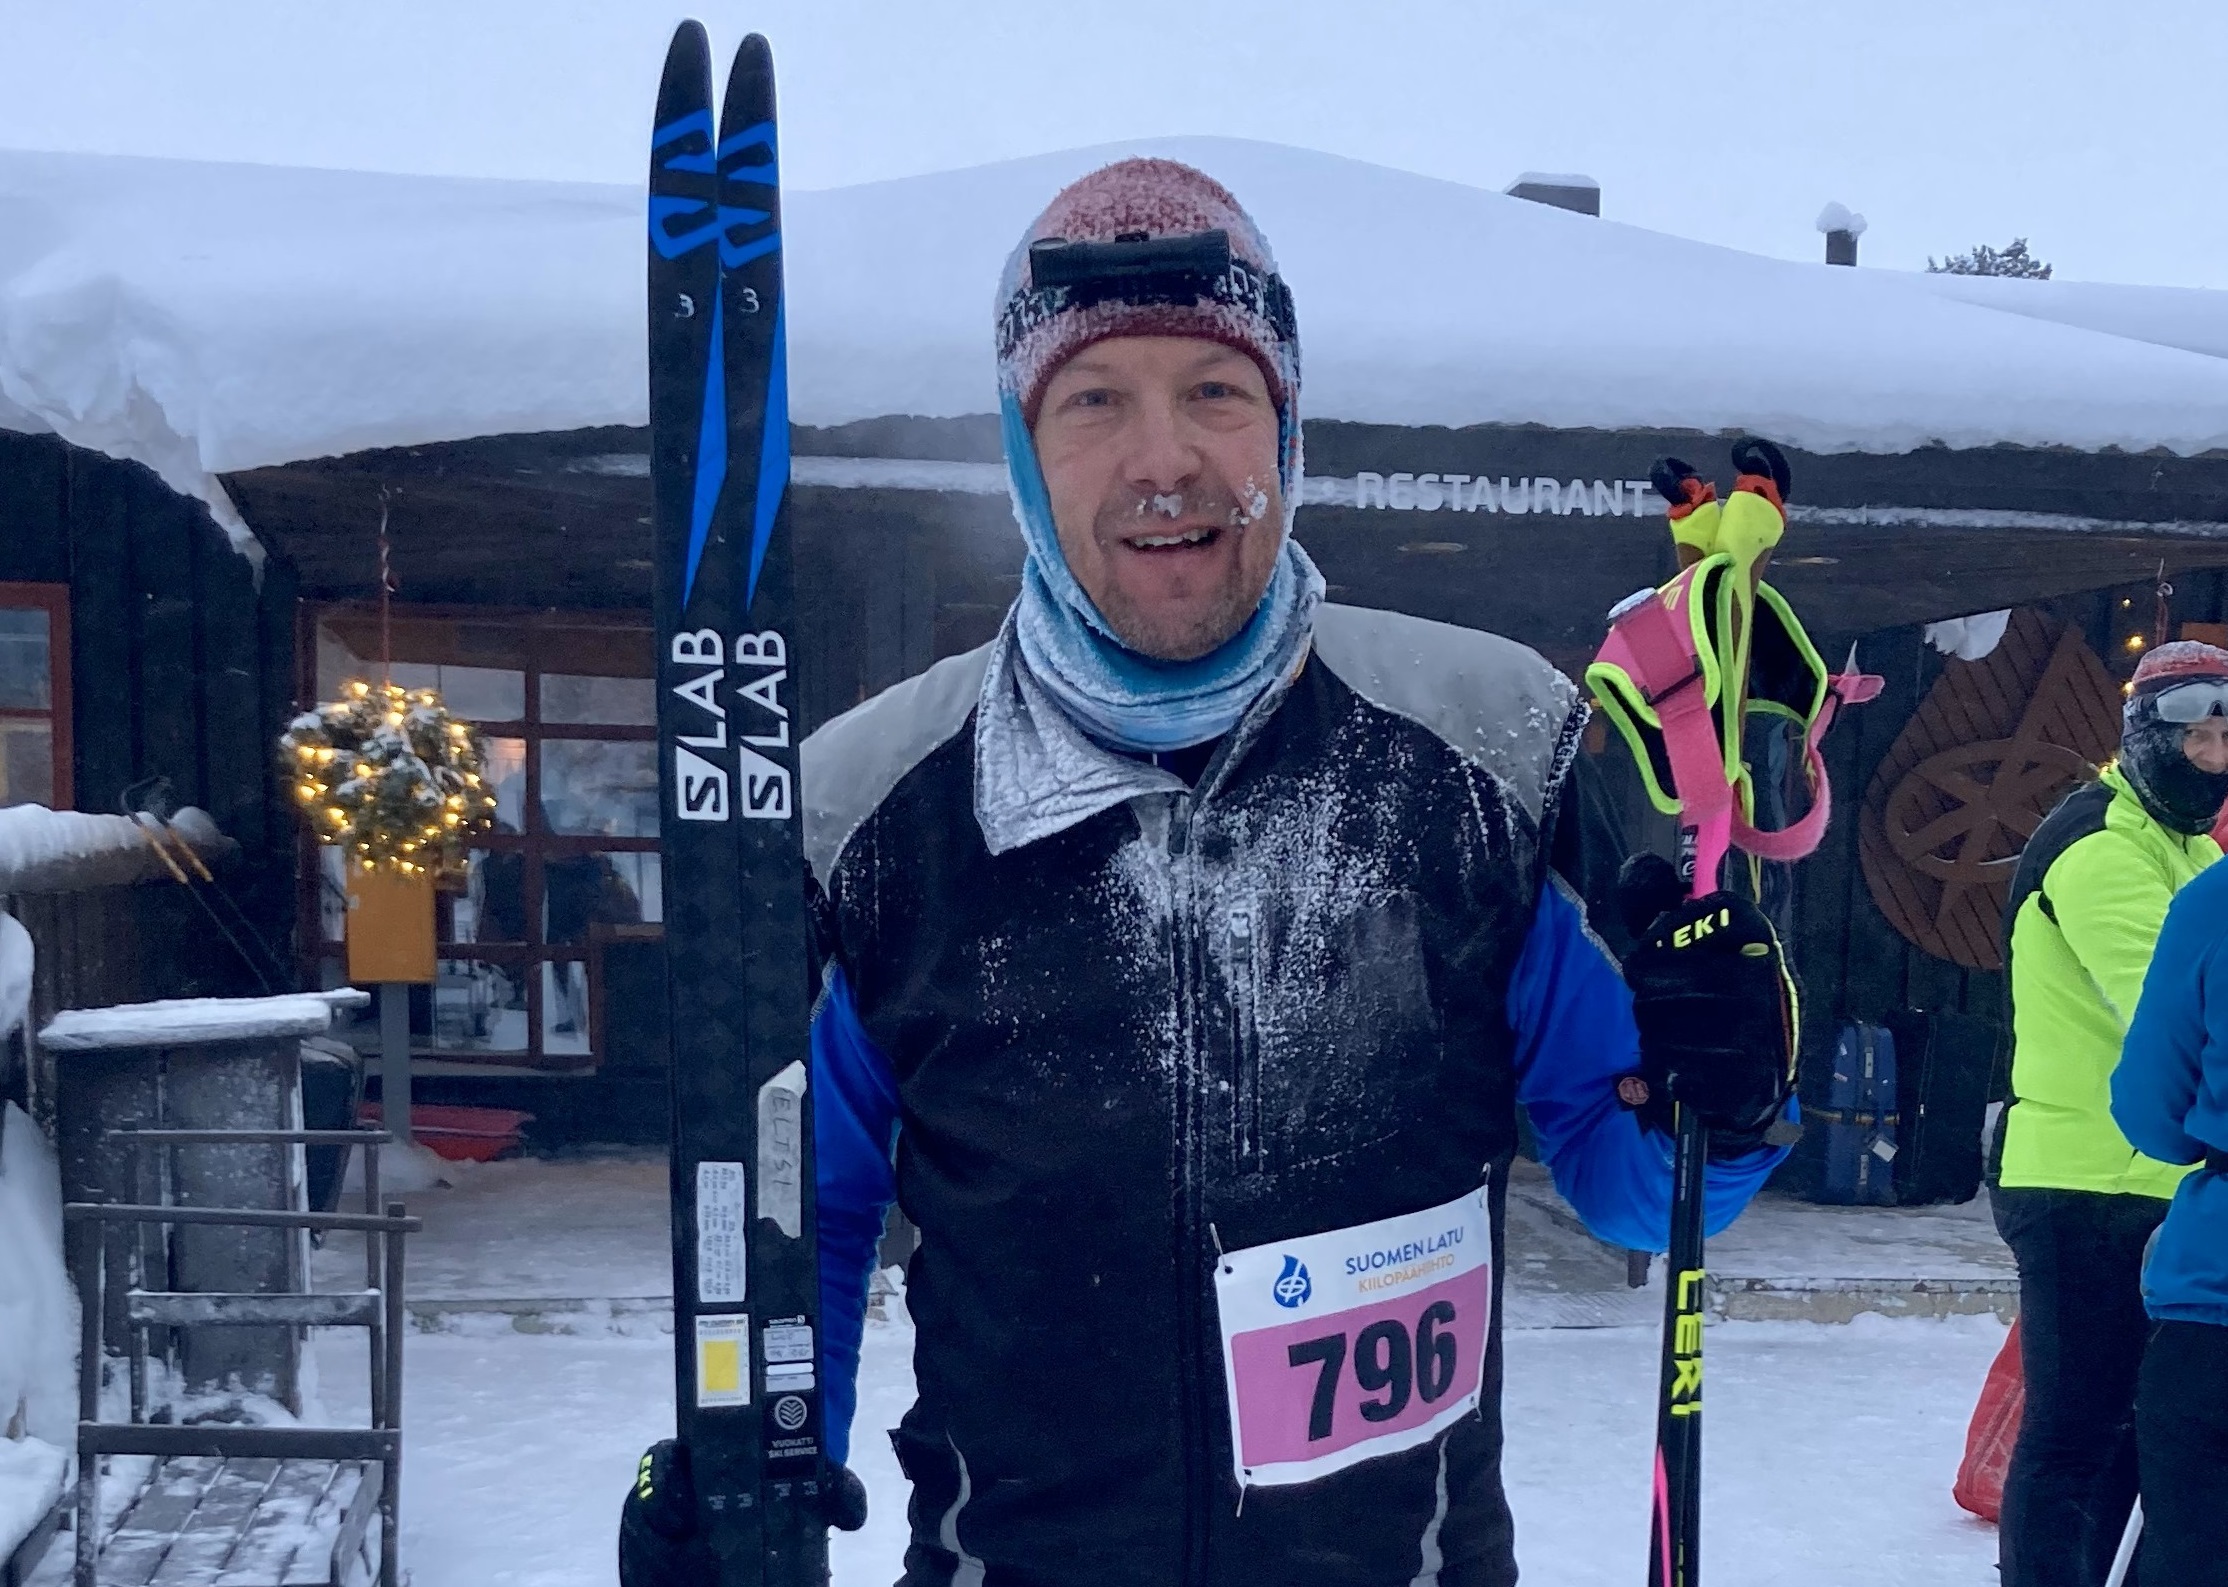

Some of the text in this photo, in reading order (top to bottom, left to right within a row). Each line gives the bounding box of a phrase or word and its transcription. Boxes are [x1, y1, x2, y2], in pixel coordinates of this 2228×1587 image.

[741, 287, 760, 313] 3
[1356, 471, 1653, 517] RESTAURANT
[1656, 908, 1730, 948] EKI
[772, 1088, 793, 1186] ELTSI
[1345, 1226, 1464, 1275] SUOMEN LATU
[1671, 1268, 1706, 1417] LEKI
[1288, 1300, 1457, 1442] 796
